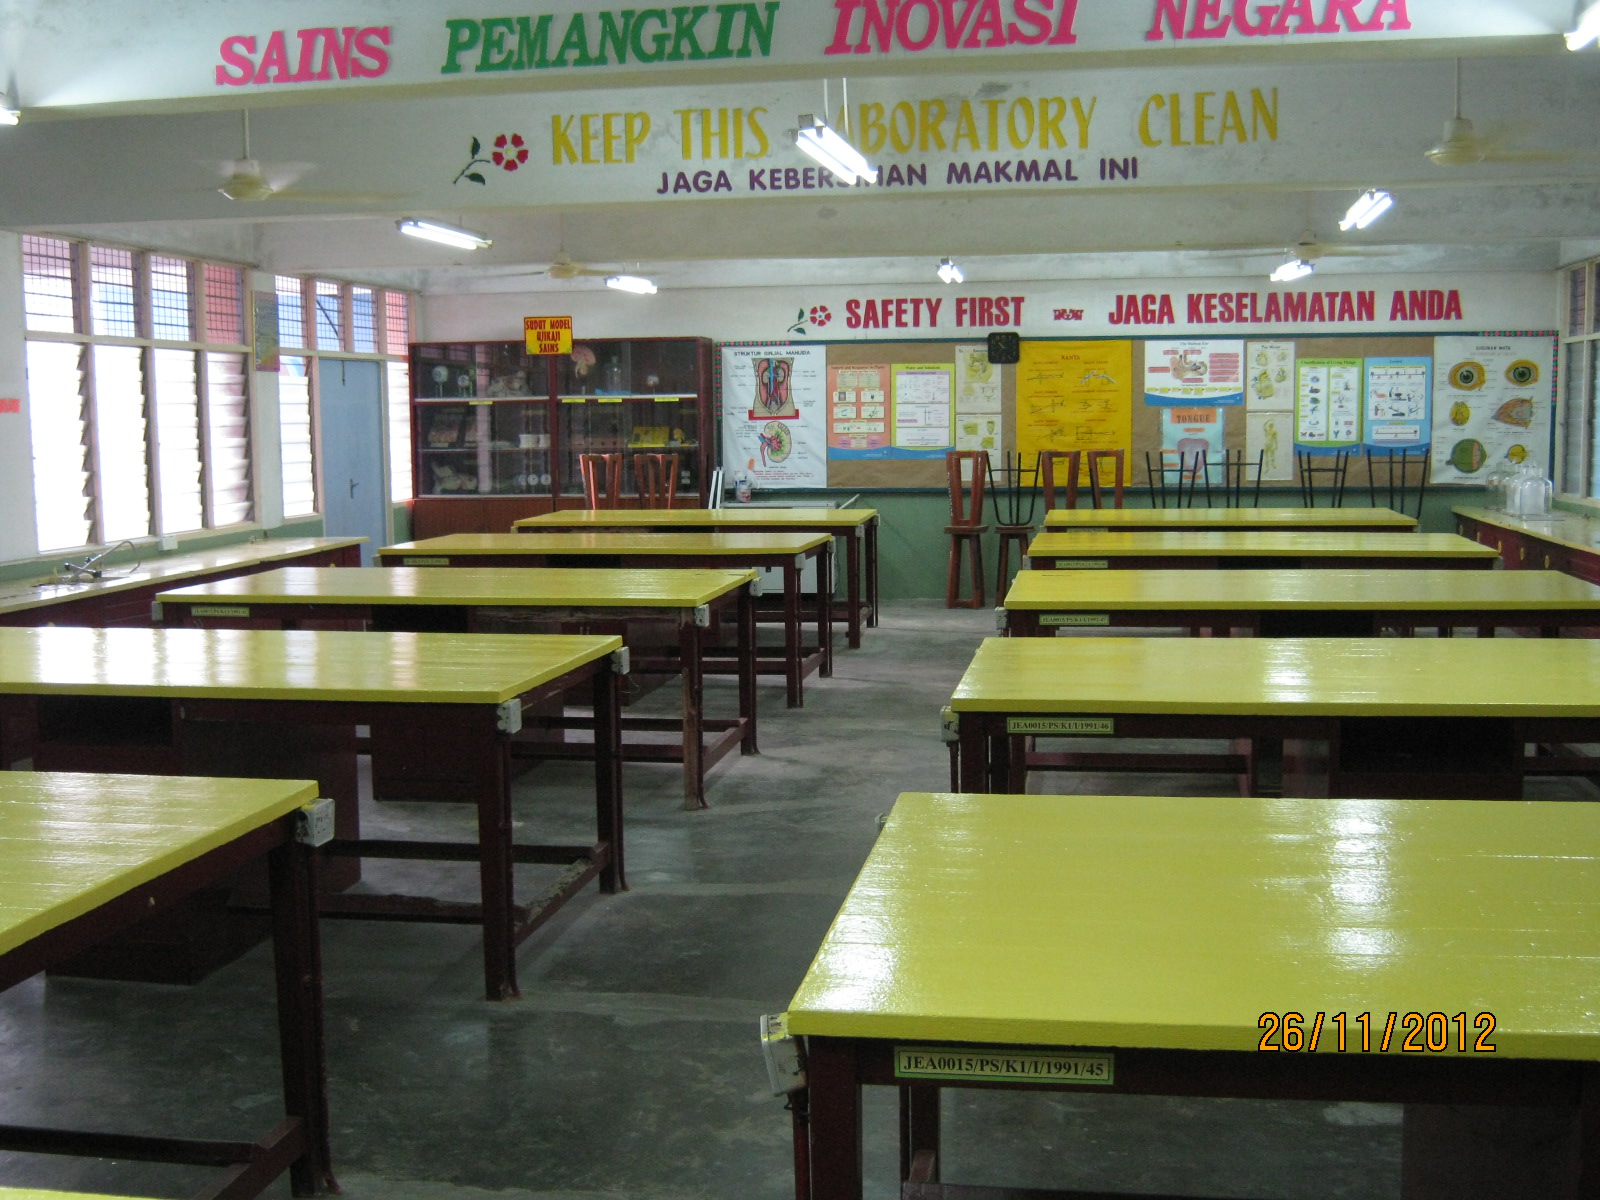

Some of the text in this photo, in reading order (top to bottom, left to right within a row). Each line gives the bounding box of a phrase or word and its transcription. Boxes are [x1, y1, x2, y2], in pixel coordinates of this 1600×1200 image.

[215, 0, 1412, 87] SAINS PEMANGKIN INOVASI NEGARA
[551, 88, 1278, 165] KEEP THIS ABORATORY CLEAN
[656, 169, 733, 195] JAGA
[946, 159, 1079, 185] MAKMAL
[1099, 156, 1139, 182] INI
[846, 289, 1463, 329] SAFETY FIRST JAGA KESELAMATAN ANDA
[526, 319, 571, 330] SUDUT MODEL
[539, 344, 559, 353] SAINS
[1176, 413, 1211, 424] TONGUE
[903, 1055, 1105, 1077] JEA0015/PS/K1/I/1991/45
